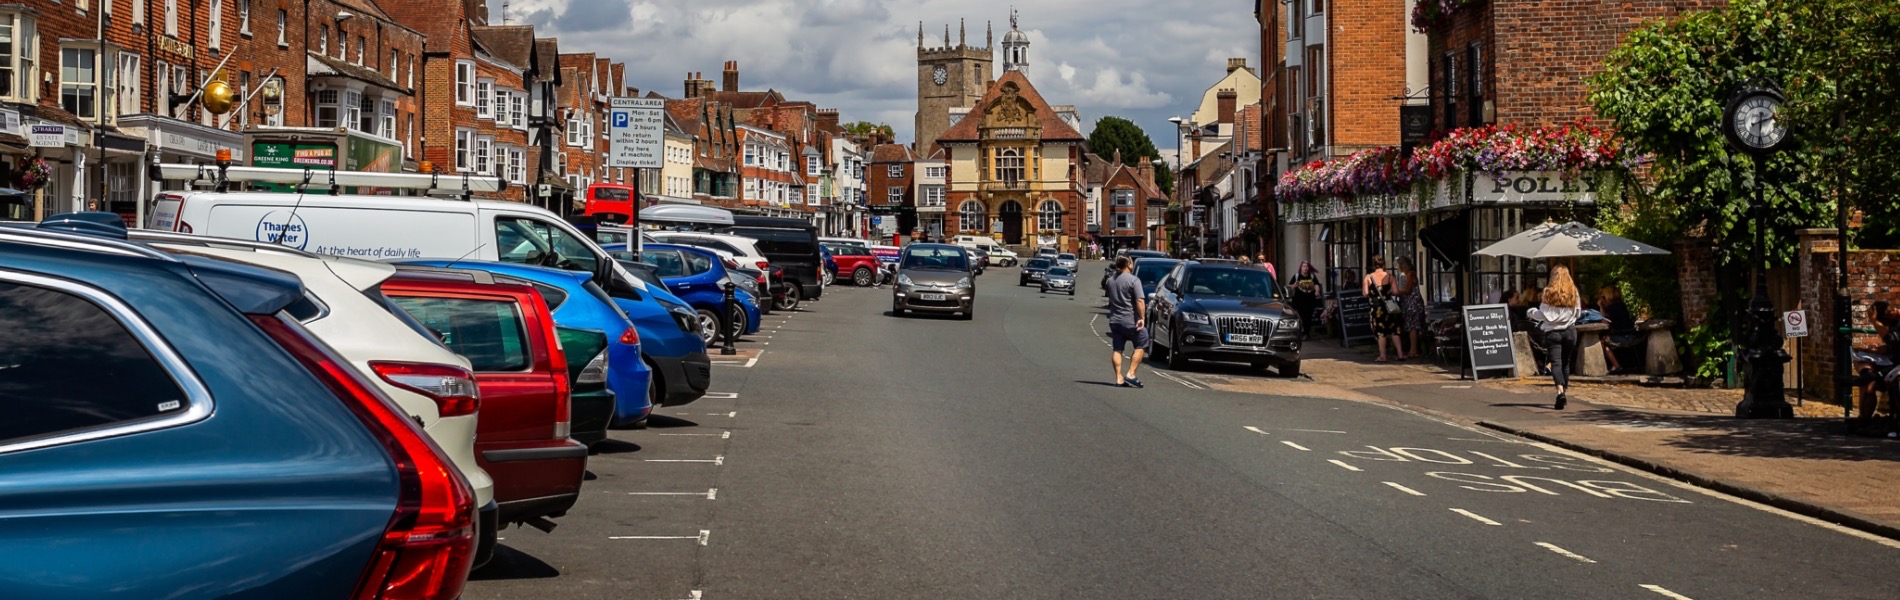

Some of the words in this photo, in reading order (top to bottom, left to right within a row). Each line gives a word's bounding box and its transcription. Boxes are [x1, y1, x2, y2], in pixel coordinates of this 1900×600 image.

[616, 113, 626, 126] P
[293, 157, 334, 165] GREENEKING.CO.UK
[263, 222, 302, 232] Thames
[316, 245, 327, 254] At
[329, 246, 345, 255] the
[347, 246, 371, 256] heart
[373, 247, 383, 258] of
[384, 247, 406, 258] daily
[408, 247, 421, 258] life
[1425, 471, 1693, 504] BUS
